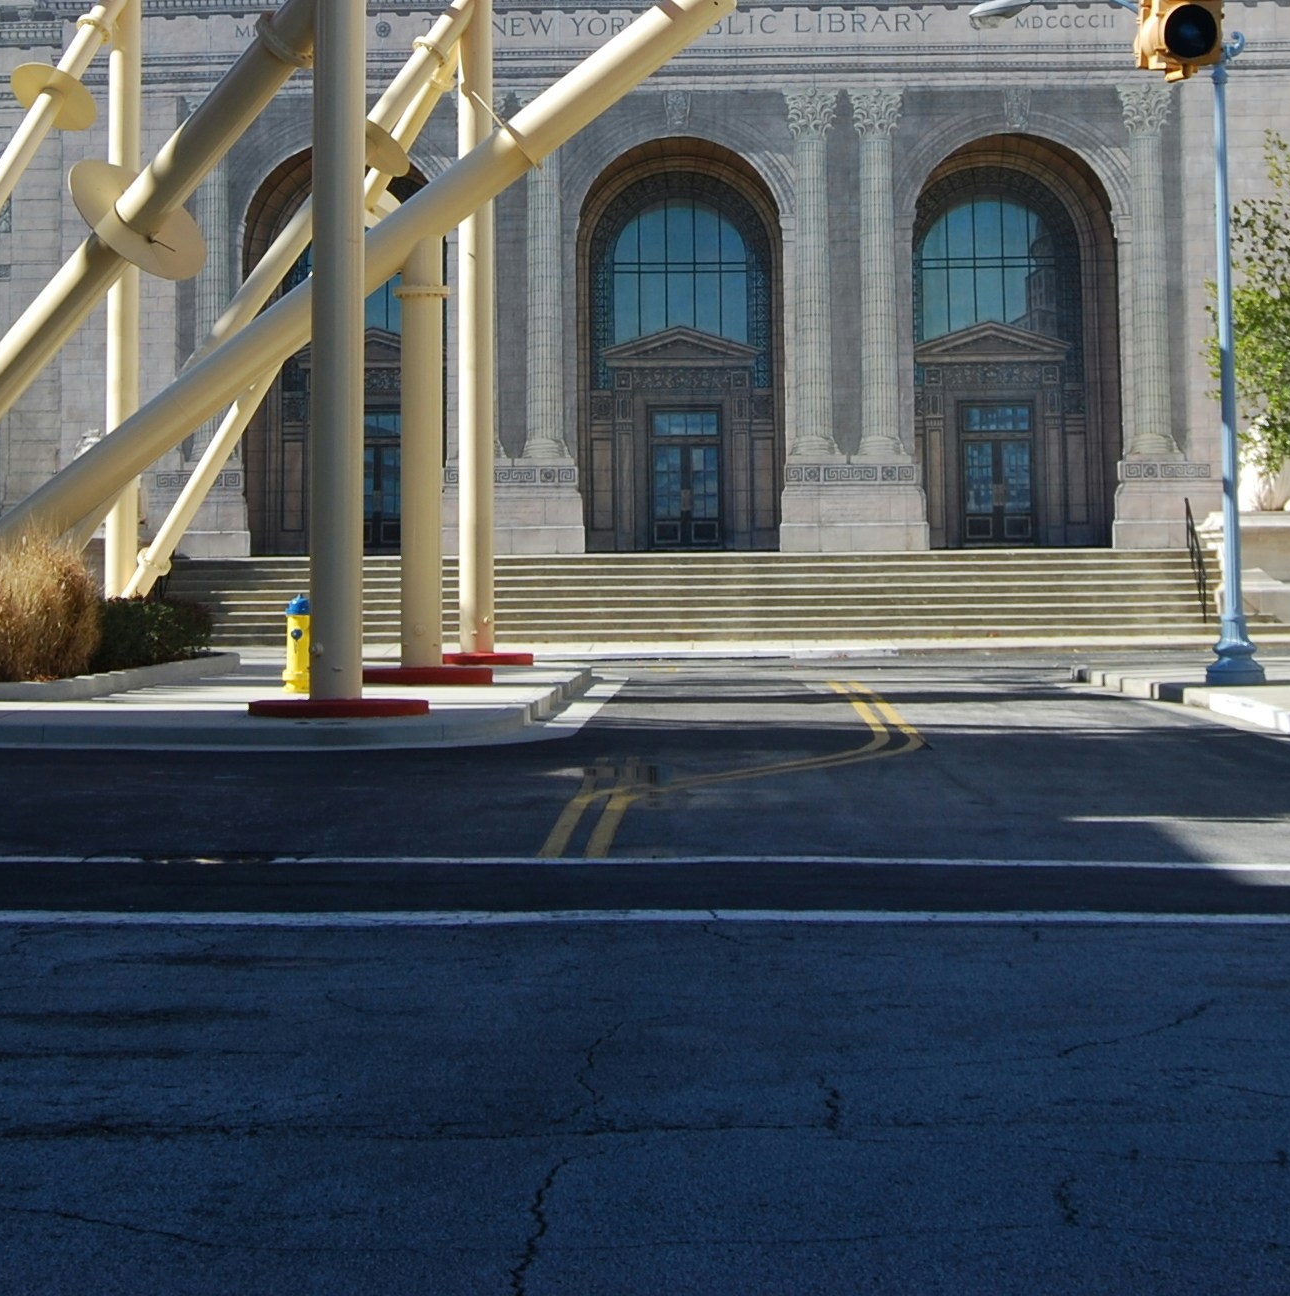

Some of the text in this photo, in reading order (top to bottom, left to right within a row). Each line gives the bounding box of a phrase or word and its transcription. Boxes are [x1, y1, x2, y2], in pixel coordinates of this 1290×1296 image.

[492, 17, 554, 37] NEW
[706, 13, 777, 35] BLIC
[794, 12, 933, 33] LIBRARY
